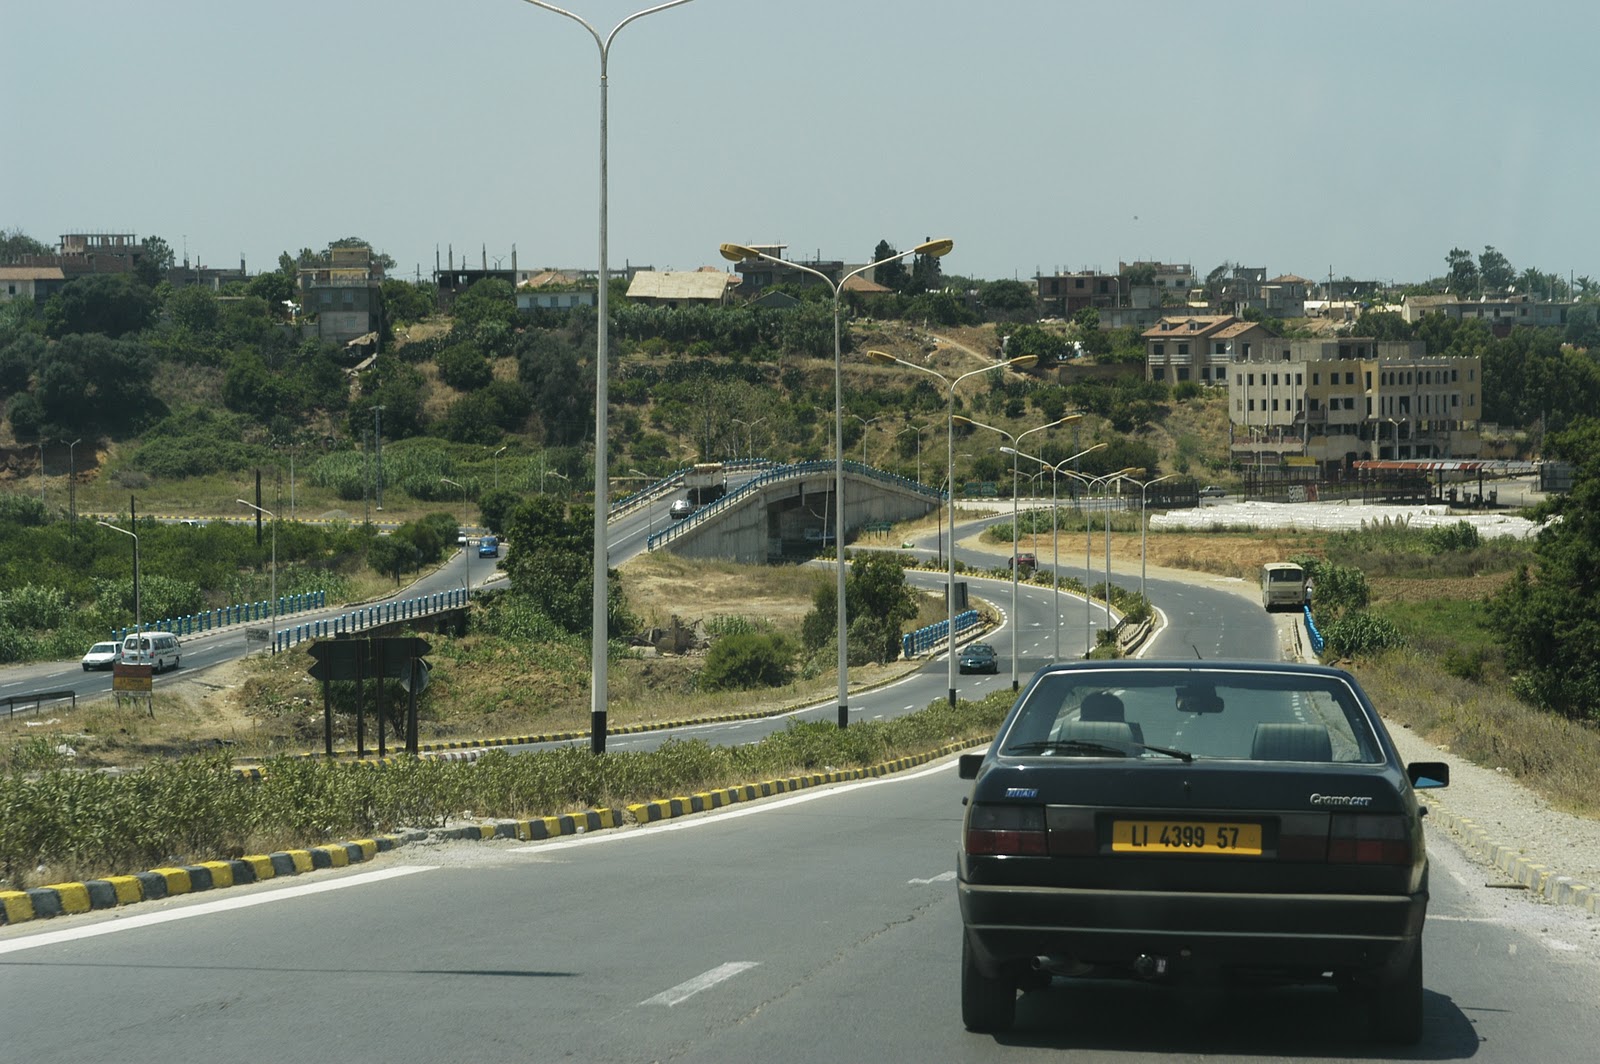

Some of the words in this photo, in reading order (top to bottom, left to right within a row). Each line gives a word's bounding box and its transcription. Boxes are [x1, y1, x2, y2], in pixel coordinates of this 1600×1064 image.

[1006, 788, 1038, 798] FIAT
[1310, 793, 1350, 805] Croma
[1159, 825, 1205, 848] 4399
[1216, 827, 1240, 849] 57
